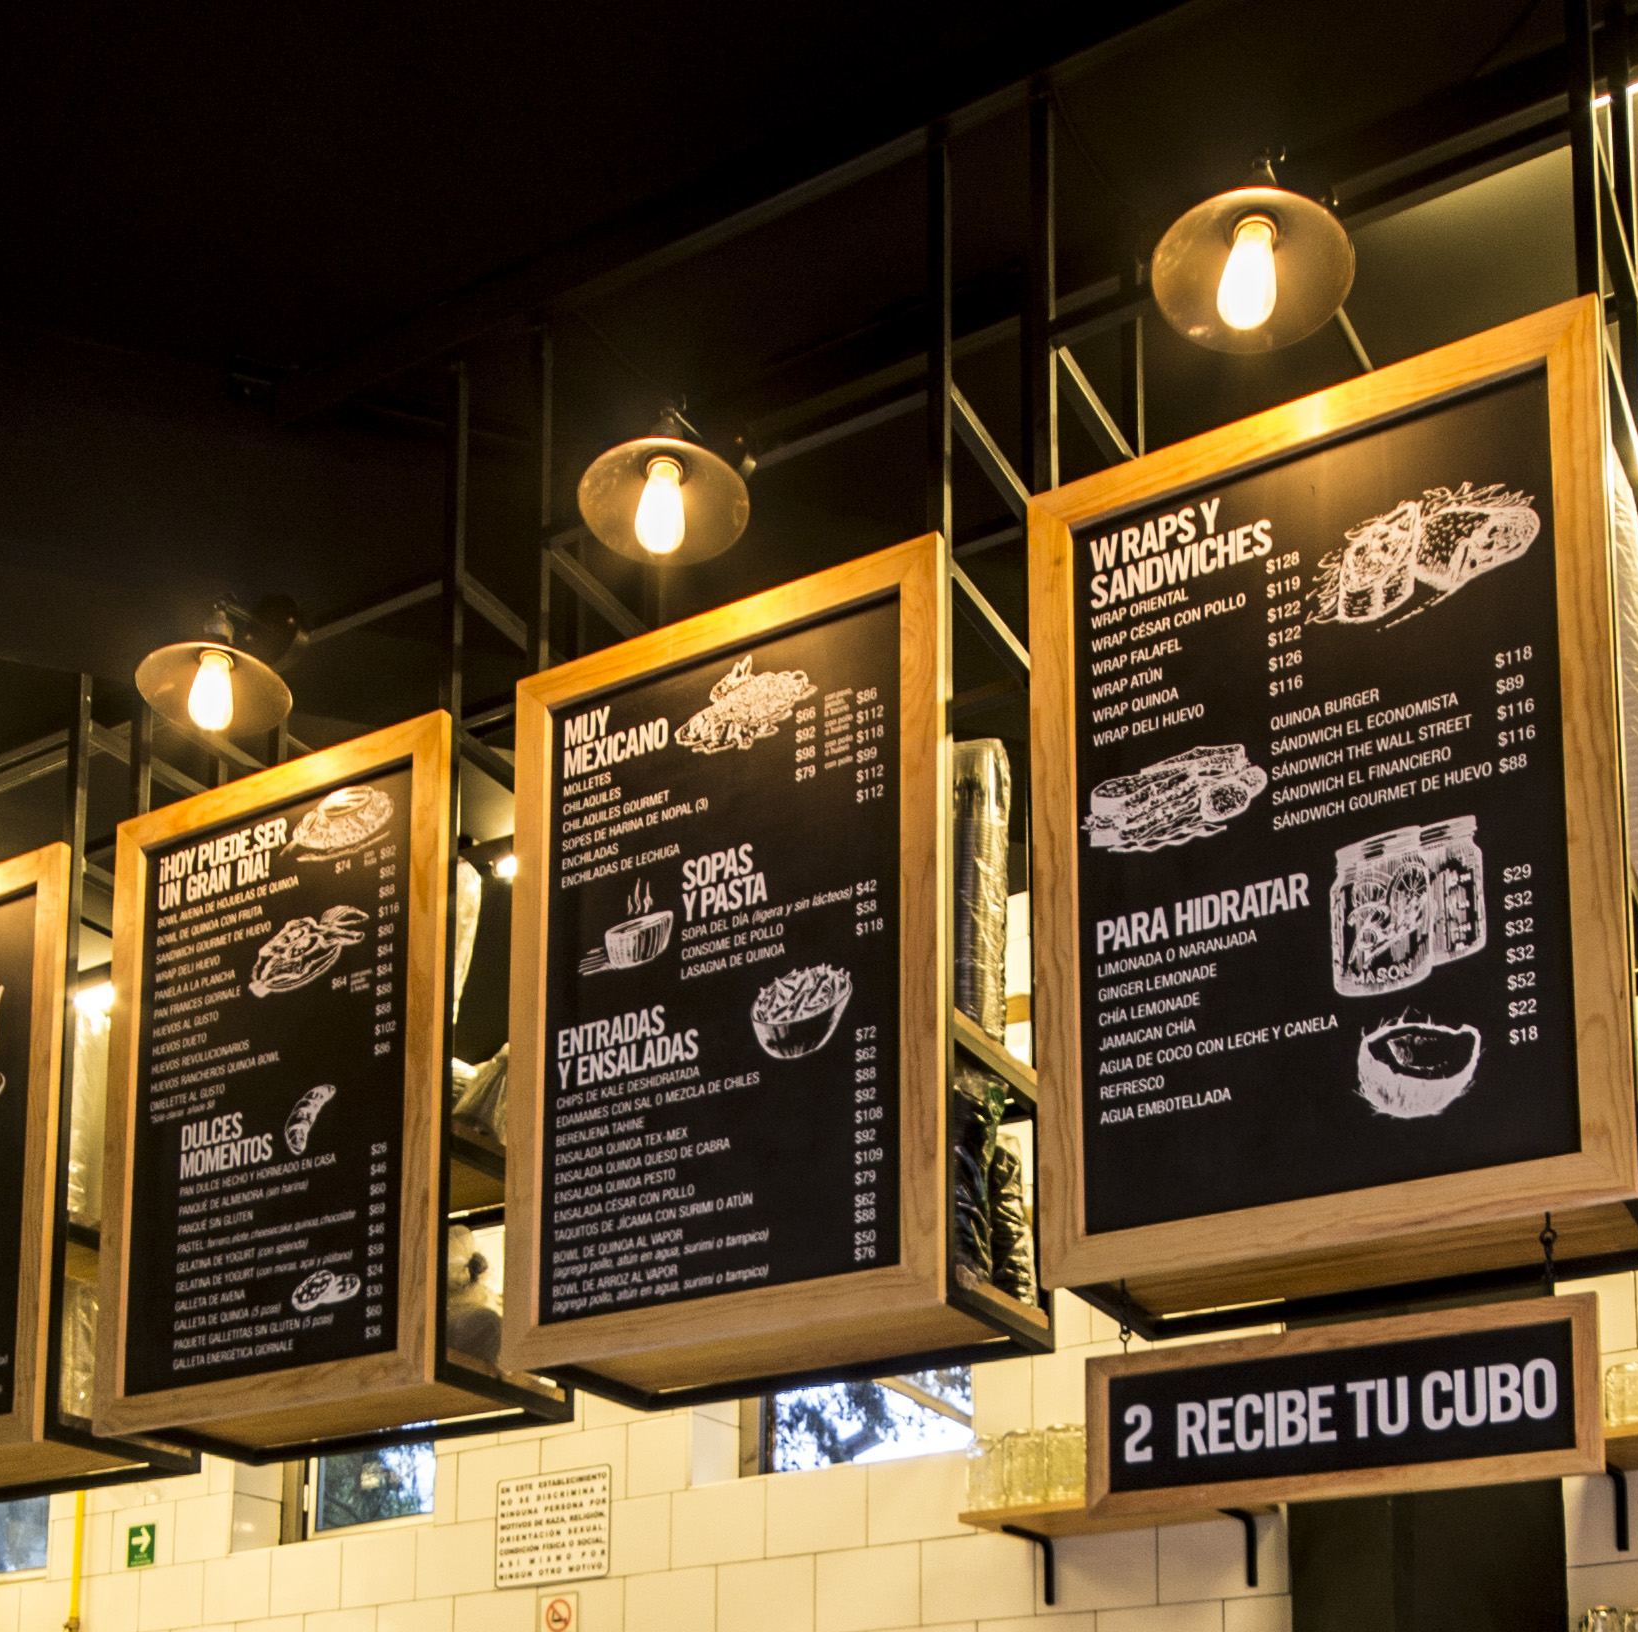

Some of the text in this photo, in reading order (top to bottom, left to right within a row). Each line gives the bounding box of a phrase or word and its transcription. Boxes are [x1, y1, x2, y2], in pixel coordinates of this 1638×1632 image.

[1089, 496, 1220, 572] WRAPS Y
[1090, 518, 1272, 609] SANDWICHES
[1265, 550, 1299, 574] $128
[1090, 587, 1188, 629] WRAP ORIENTAL
[1495, 645, 1532, 668] $118
[856, 686, 877, 705] $86
[1496, 674, 1524, 694] $89
[564, 705, 610, 748] MUY
[795, 705, 816, 724] $66
[1270, 687, 1379, 730] QUINOA BURGER
[1271, 692, 1458, 755] SÁNDWICH EL ECONOMISTA
[563, 717, 668, 779] MEXICANO
[795, 745, 815, 763] $98
[563, 771, 611, 797] MOLLETES
[562, 789, 669, 833] CHILAQUILES GOURMET
[159, 817, 288, 884] ¡HOY PUEDE SER
[682, 842, 753, 890] SOPAS
[158, 849, 271, 911] UN GRAN DÍA!
[1503, 863, 1531, 883] $29
[682, 871, 767, 921] Y PASTA
[1096, 872, 1310, 954] PARA HIDRATAR
[680, 942, 785, 980] LASAGNA DE QUINOA
[1097, 929, 1257, 978] LIMONADA O NARANJADA
[1508, 998, 1536, 1018] $22
[557, 1004, 665, 1059] ENTRADAS
[855, 1025, 876, 1042] $72
[557, 1028, 698, 1089] Y ENSALADAS
[1100, 1074, 1164, 1100] REFRESCO
[1100, 1087, 1231, 1124] AGUA EMBOTELLADA
[854, 1105, 883, 1124] $108
[1124, 1358, 1557, 1463] 2 RECIBE TU CUBO
